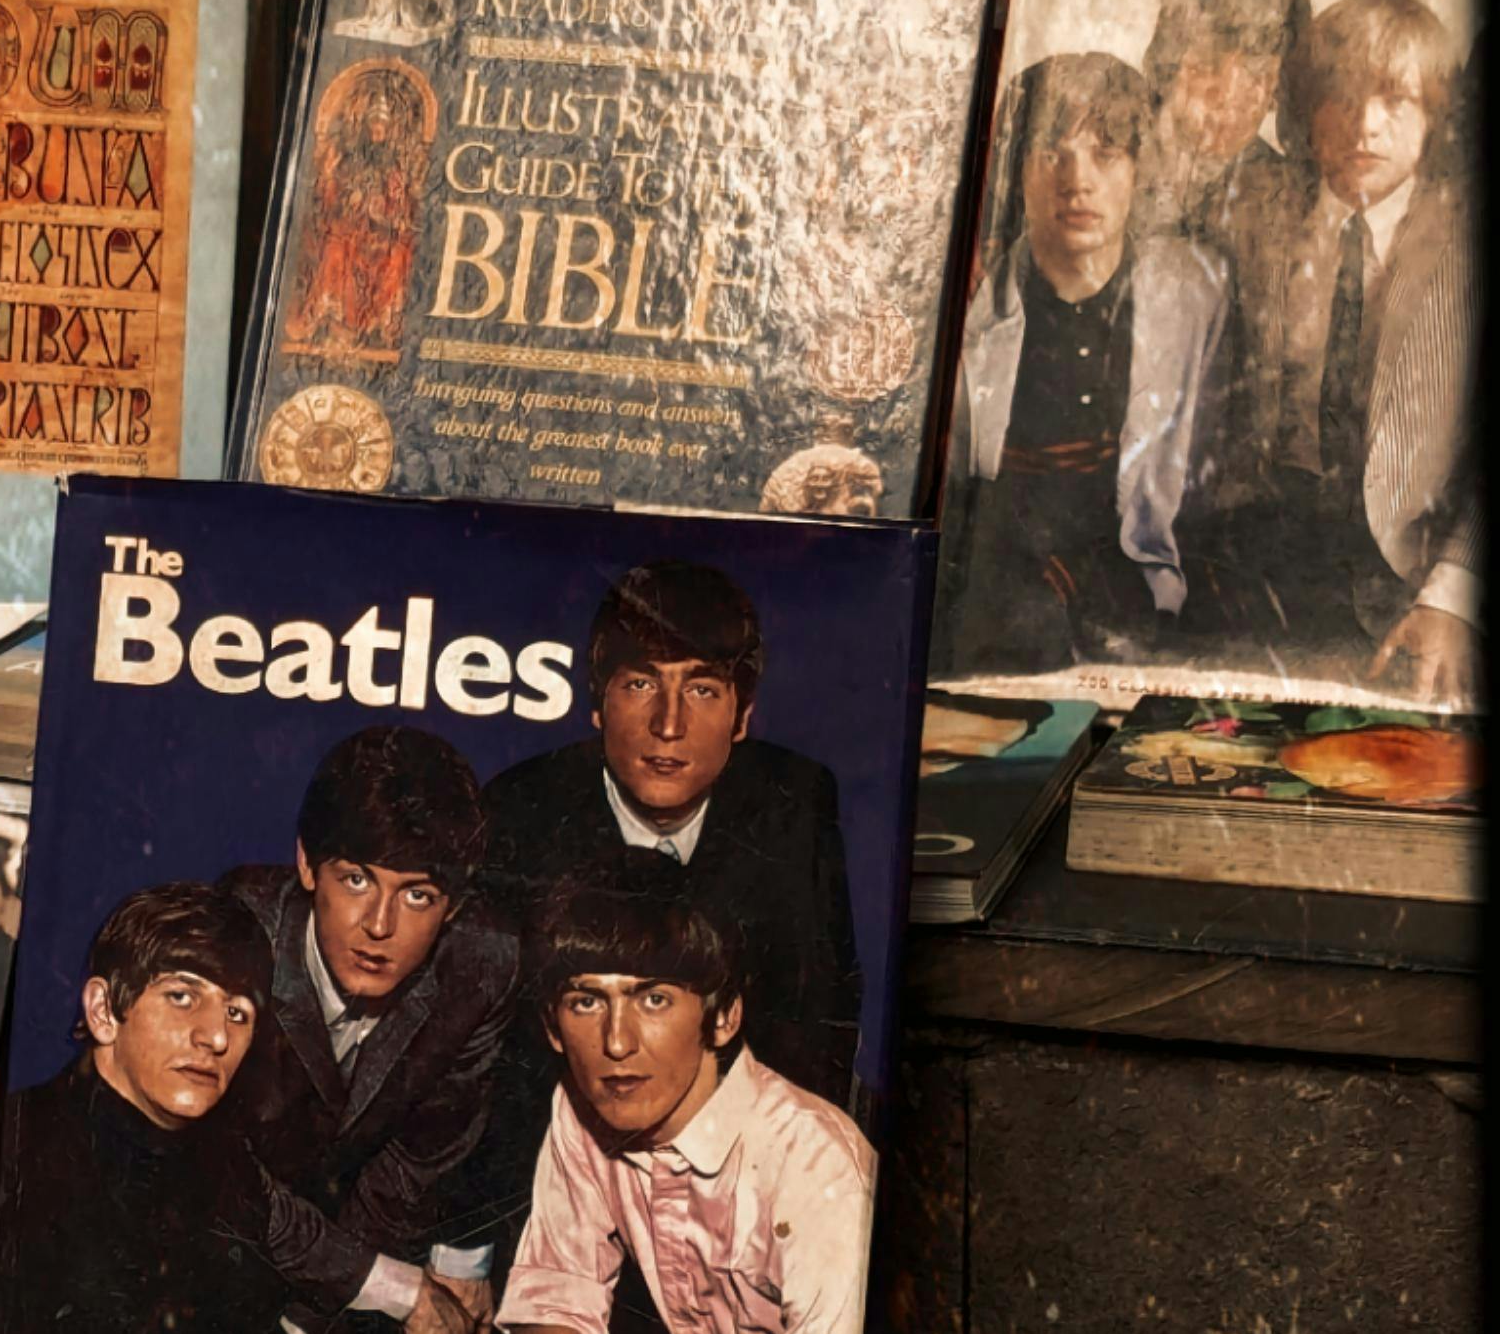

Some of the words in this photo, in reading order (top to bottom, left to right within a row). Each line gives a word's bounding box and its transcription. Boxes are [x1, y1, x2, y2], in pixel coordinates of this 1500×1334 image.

[444, 141, 601, 202] GUIDE
[611, 150, 675, 207] TO
[425, 202, 759, 348] BIBLE
[413, 375, 515, 417] Intriguing
[520, 389, 614, 425] questions
[617, 396, 658, 423] and
[660, 404, 741, 428] answers
[434, 416, 493, 443] about
[497, 419, 527, 445] the
[529, 425, 609, 456] greatest
[614, 431, 663, 457] book
[667, 440, 708, 463] ever
[528, 460, 602, 487] written
[104, 535, 185, 579] The
[92, 571, 575, 724] Beatles
